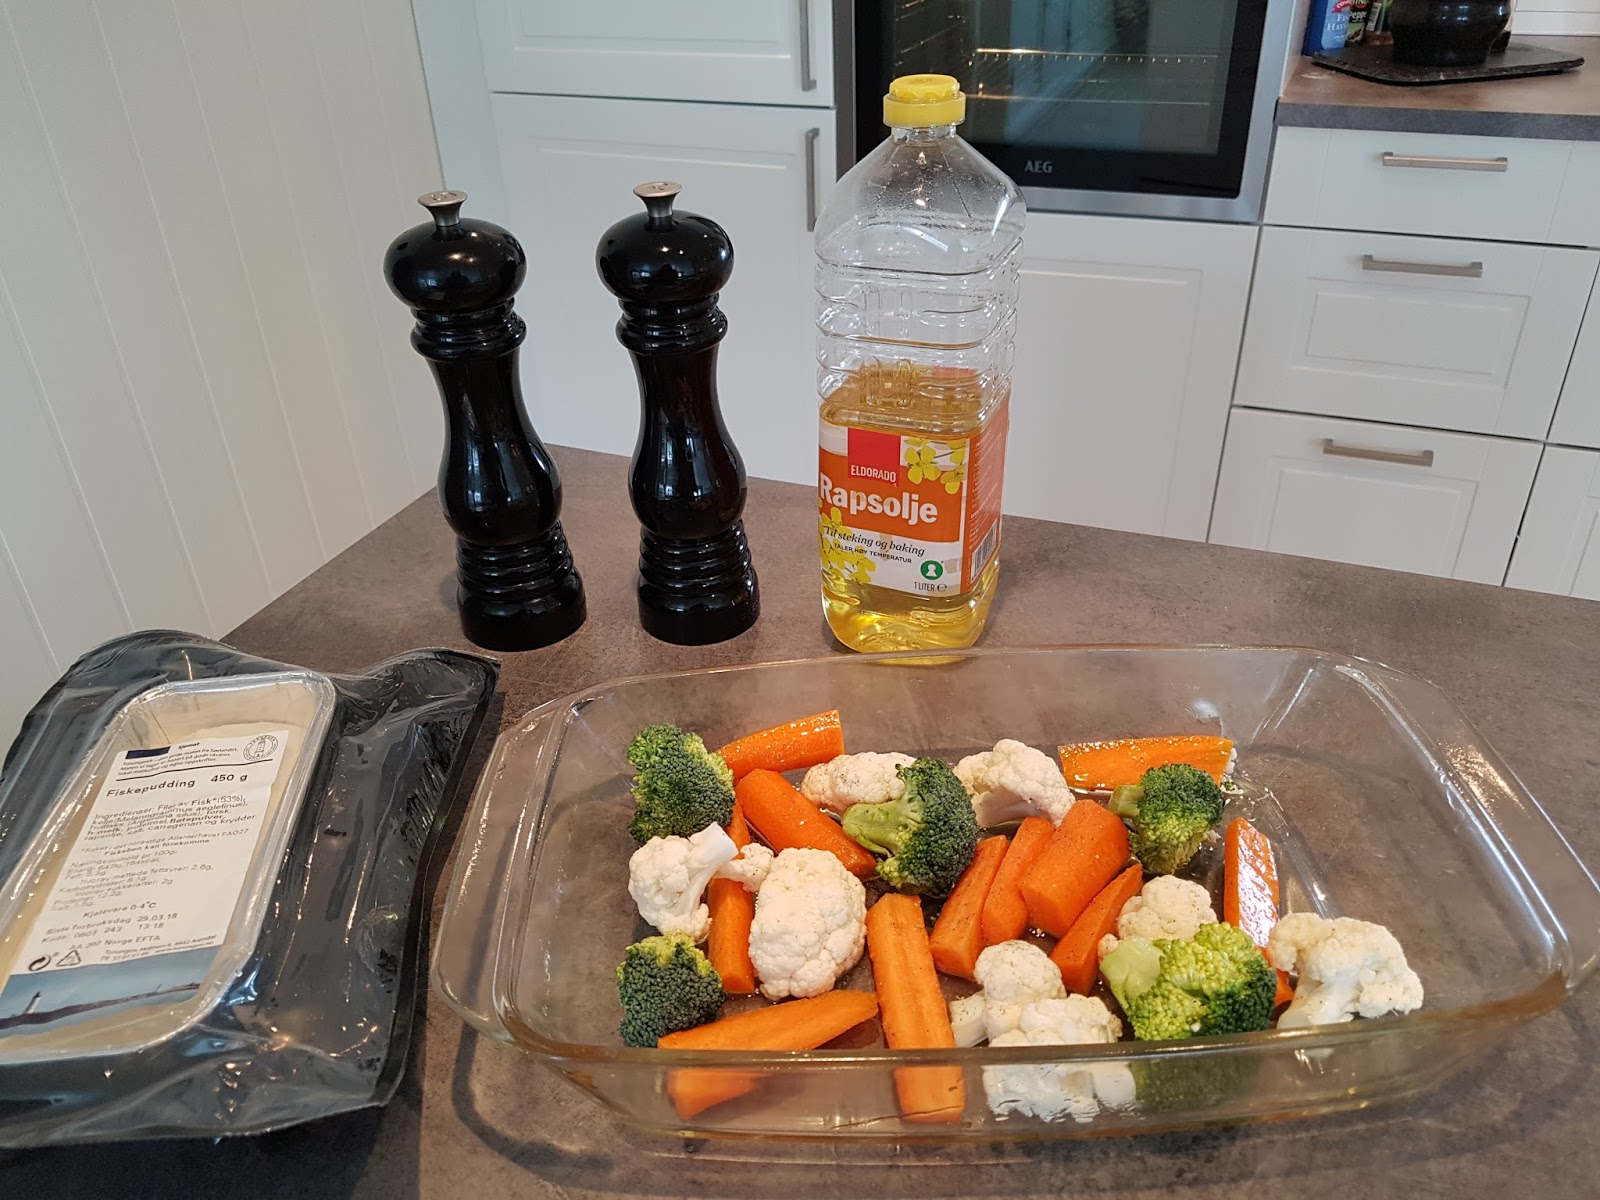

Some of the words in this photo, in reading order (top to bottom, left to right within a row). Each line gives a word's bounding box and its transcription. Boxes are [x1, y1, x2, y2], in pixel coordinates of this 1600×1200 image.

[1024, 160, 1053, 174] AEG
[850, 464, 896, 482] ELDORADO
[820, 472, 938, 526] Rapsolje
[822, 525, 837, 537] Til
[837, 533, 873, 547] steking
[875, 540, 888, 550] og
[890, 540, 925, 557] baking
[870, 550, 912, 564] TEMPERATUR
[914, 581, 917, 589] 1
[919, 582, 935, 592] LITER
[106, 780, 196, 797] Fiskepudding
[95, 807, 154, 820] Ingredienser:
[162, 839, 210, 847] forekomme
[72, 918, 131, 930] forbruksdag
